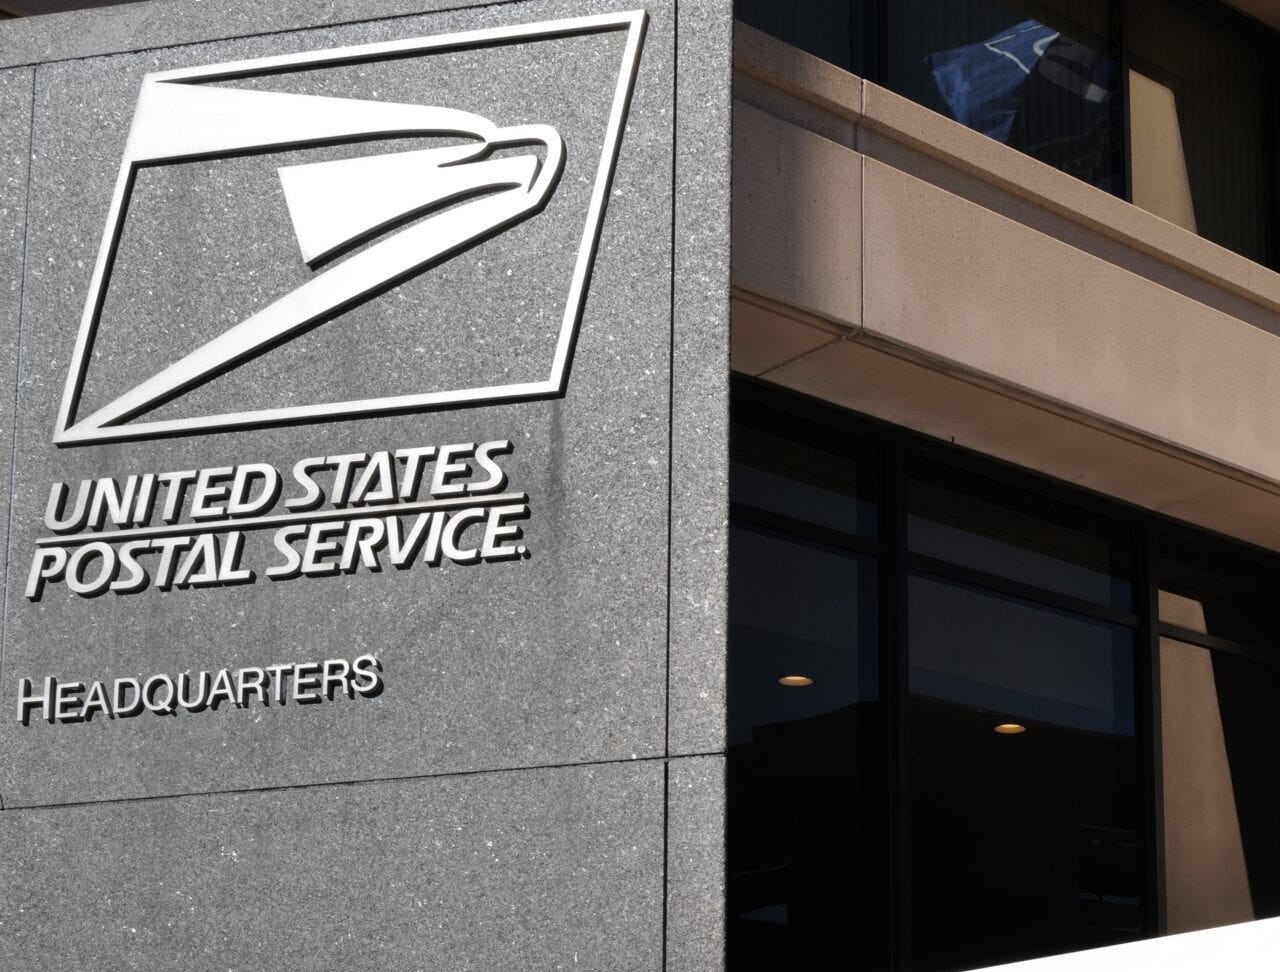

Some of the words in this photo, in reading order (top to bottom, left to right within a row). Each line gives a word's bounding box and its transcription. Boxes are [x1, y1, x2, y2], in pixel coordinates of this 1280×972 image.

[45, 463, 279, 532] UNITED
[286, 440, 510, 508] STATES
[24, 531, 252, 598] POSTAL
[16, 654, 380, 723] HEADQUARTERS
